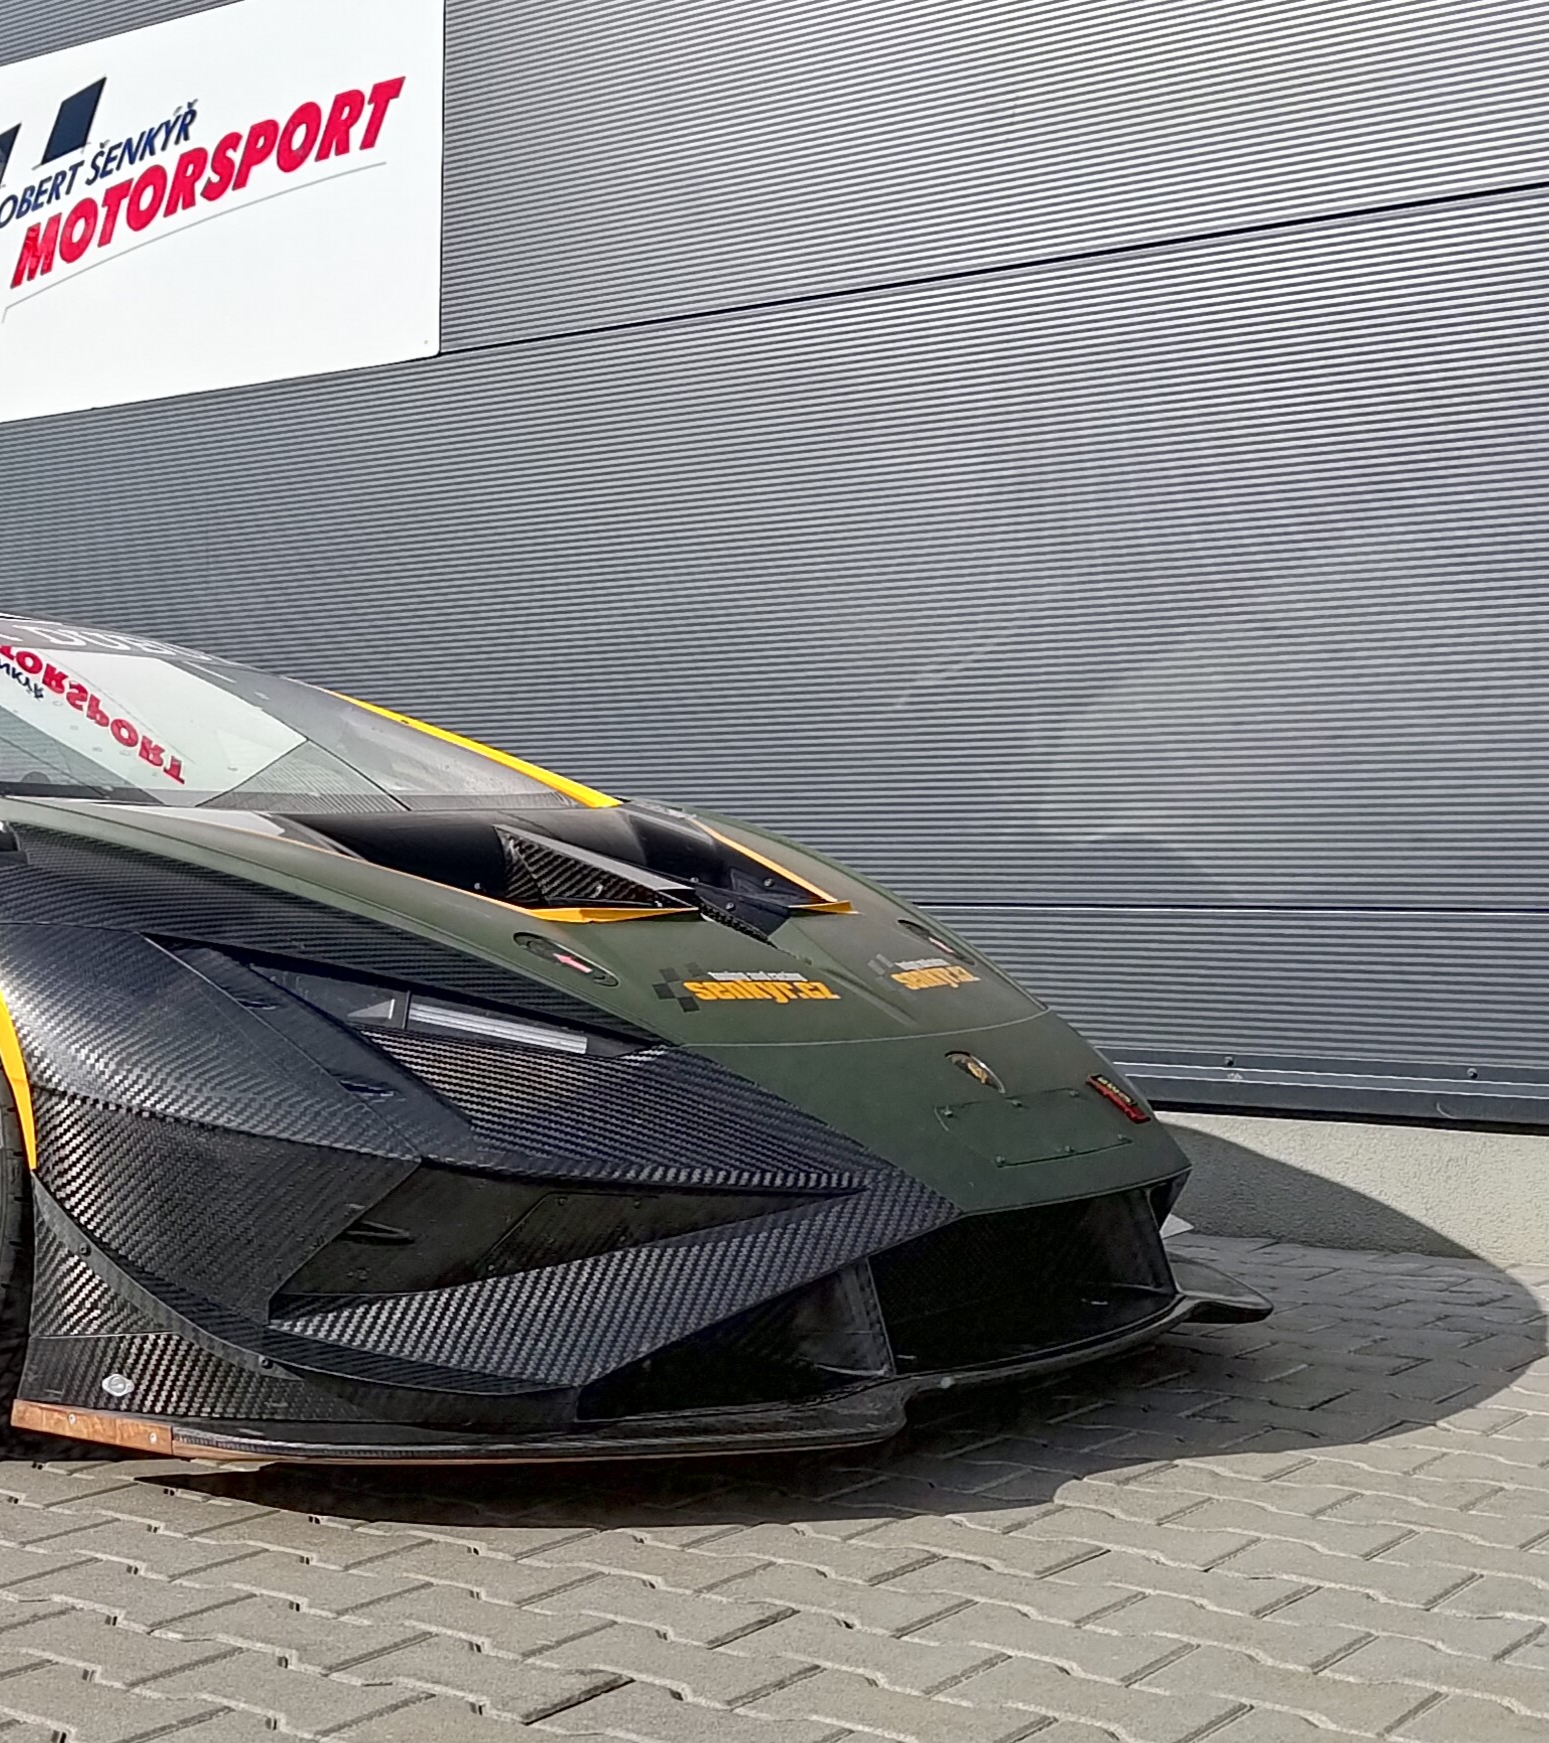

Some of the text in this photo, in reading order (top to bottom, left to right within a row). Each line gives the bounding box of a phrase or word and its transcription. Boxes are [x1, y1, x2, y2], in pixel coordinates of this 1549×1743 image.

[10, 76, 406, 289] MOTORSPORT
[85, 99, 198, 186] ŠENKÝŘ
[683, 979, 842, 1004] senkyr.cz
